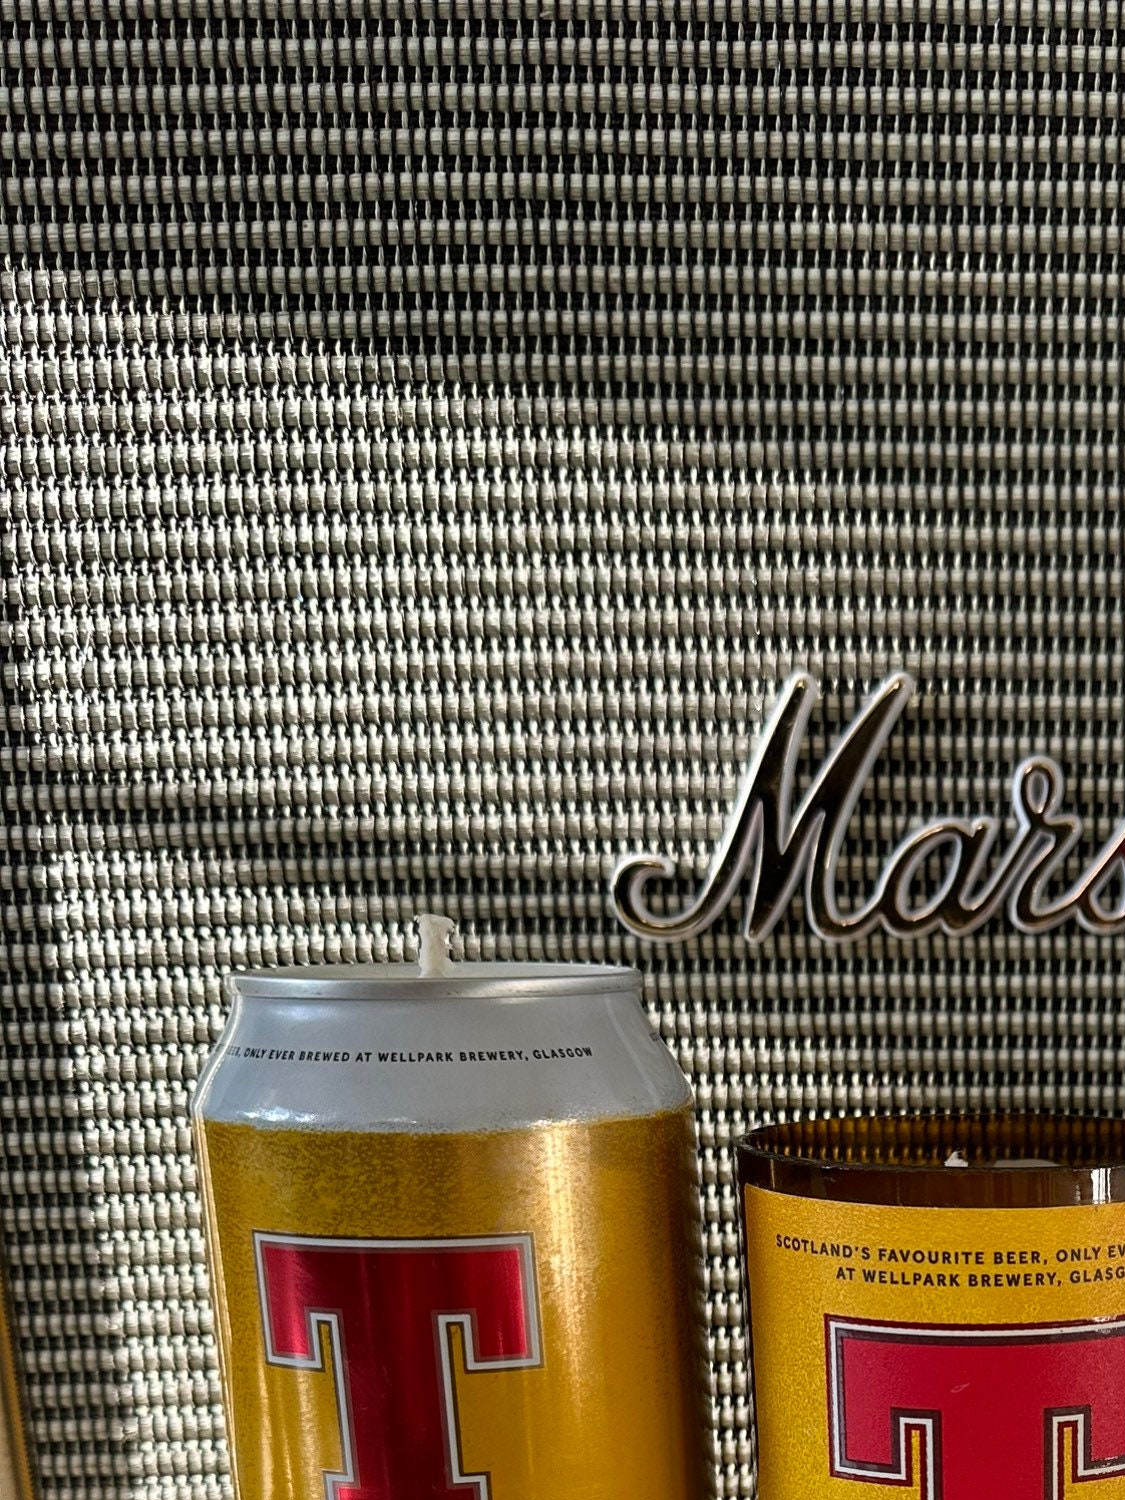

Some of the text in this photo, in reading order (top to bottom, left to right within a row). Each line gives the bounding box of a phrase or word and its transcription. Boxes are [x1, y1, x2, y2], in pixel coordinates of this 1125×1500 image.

[244, 1048, 267, 1060] ONLY
[268, 1049, 294, 1061] EVER
[299, 1051, 350, 1062] BREWED
[355, 1052, 373, 1062] AT
[378, 1052, 453, 1062] WELLPARK
[459, 1050, 529, 1062] BREWERY,
[532, 1047, 593, 1060] GLASGOW
[775, 1233, 871, 1260] SCOTLAND'S
[878, 1248, 985, 1266] FAVOURITE
[994, 1249, 1048, 1266] BEER,
[1055, 1245, 1100, 1263] ONLY
[836, 1266, 856, 1281] AT
[863, 1269, 960, 1287] WELLPARK
[968, 1272, 1062, 1288] BREWERY,
